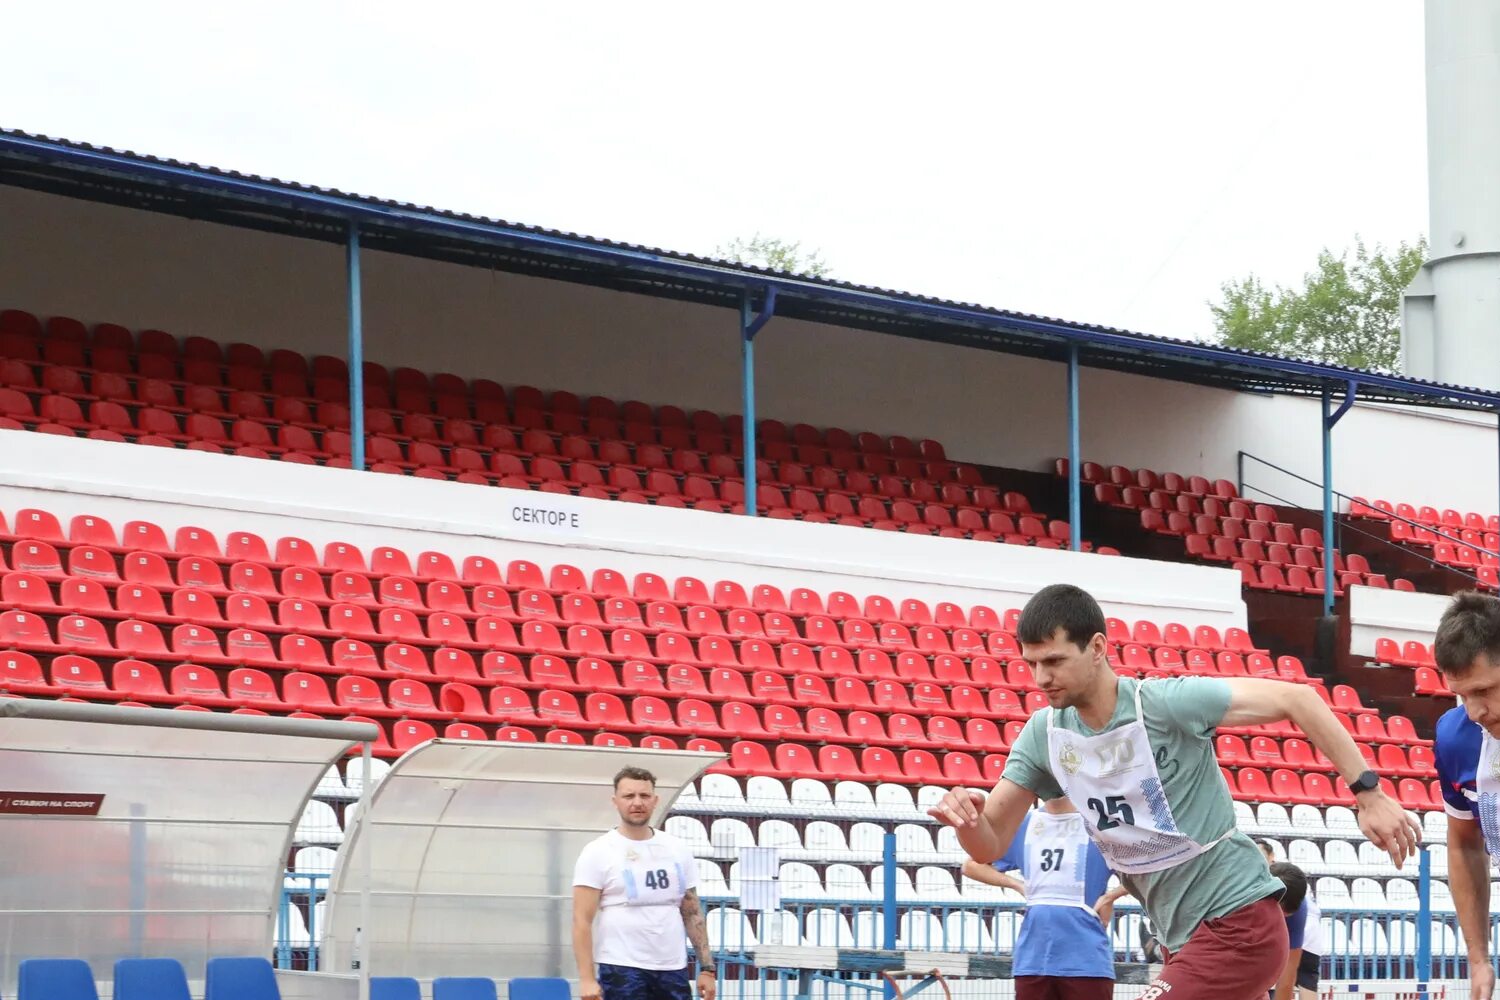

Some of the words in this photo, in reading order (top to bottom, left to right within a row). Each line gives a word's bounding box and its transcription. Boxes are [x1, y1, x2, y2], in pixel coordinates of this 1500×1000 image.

[512, 507, 566, 526] СЕКТОР
[1087, 795, 1135, 832] 25
[1040, 848, 1065, 872] 37
[645, 869, 670, 890] 48
